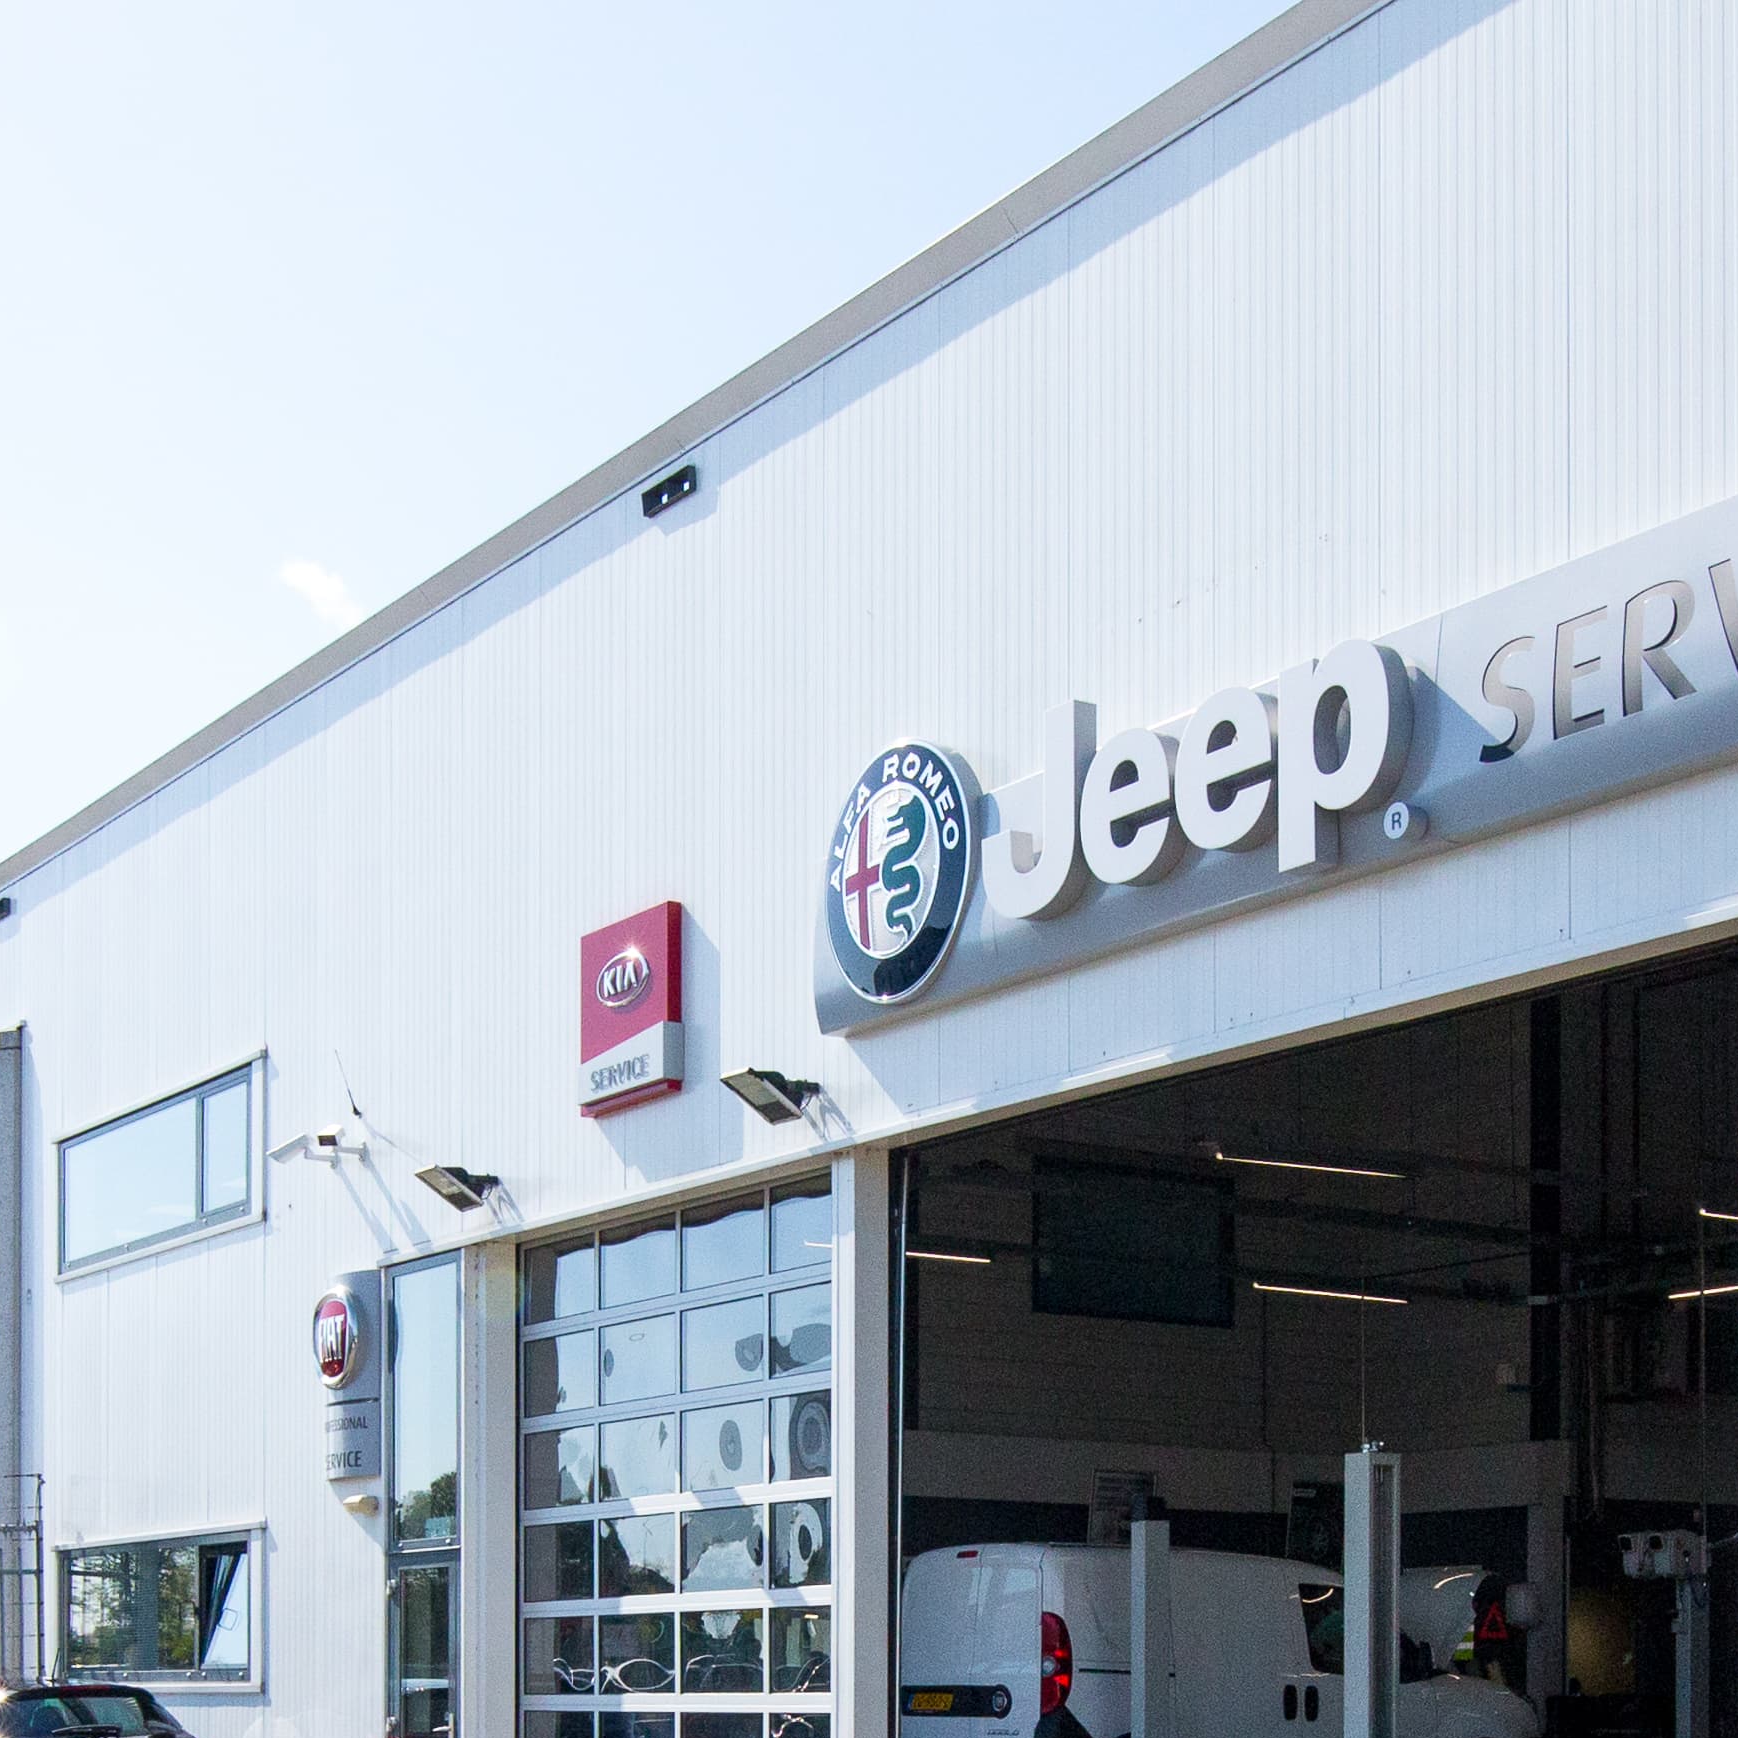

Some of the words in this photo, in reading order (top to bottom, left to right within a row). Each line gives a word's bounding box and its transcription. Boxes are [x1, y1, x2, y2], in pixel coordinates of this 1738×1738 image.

[983, 639, 1412, 920] Jeep
[830, 782, 871, 892] ALFA
[882, 752, 960, 850] ROMEO
[603, 961, 638, 998] KIA
[591, 1054, 649, 1092] SERVICE
[319, 1313, 345, 1363] FIAT
[326, 1450, 363, 1471] ERVICE
